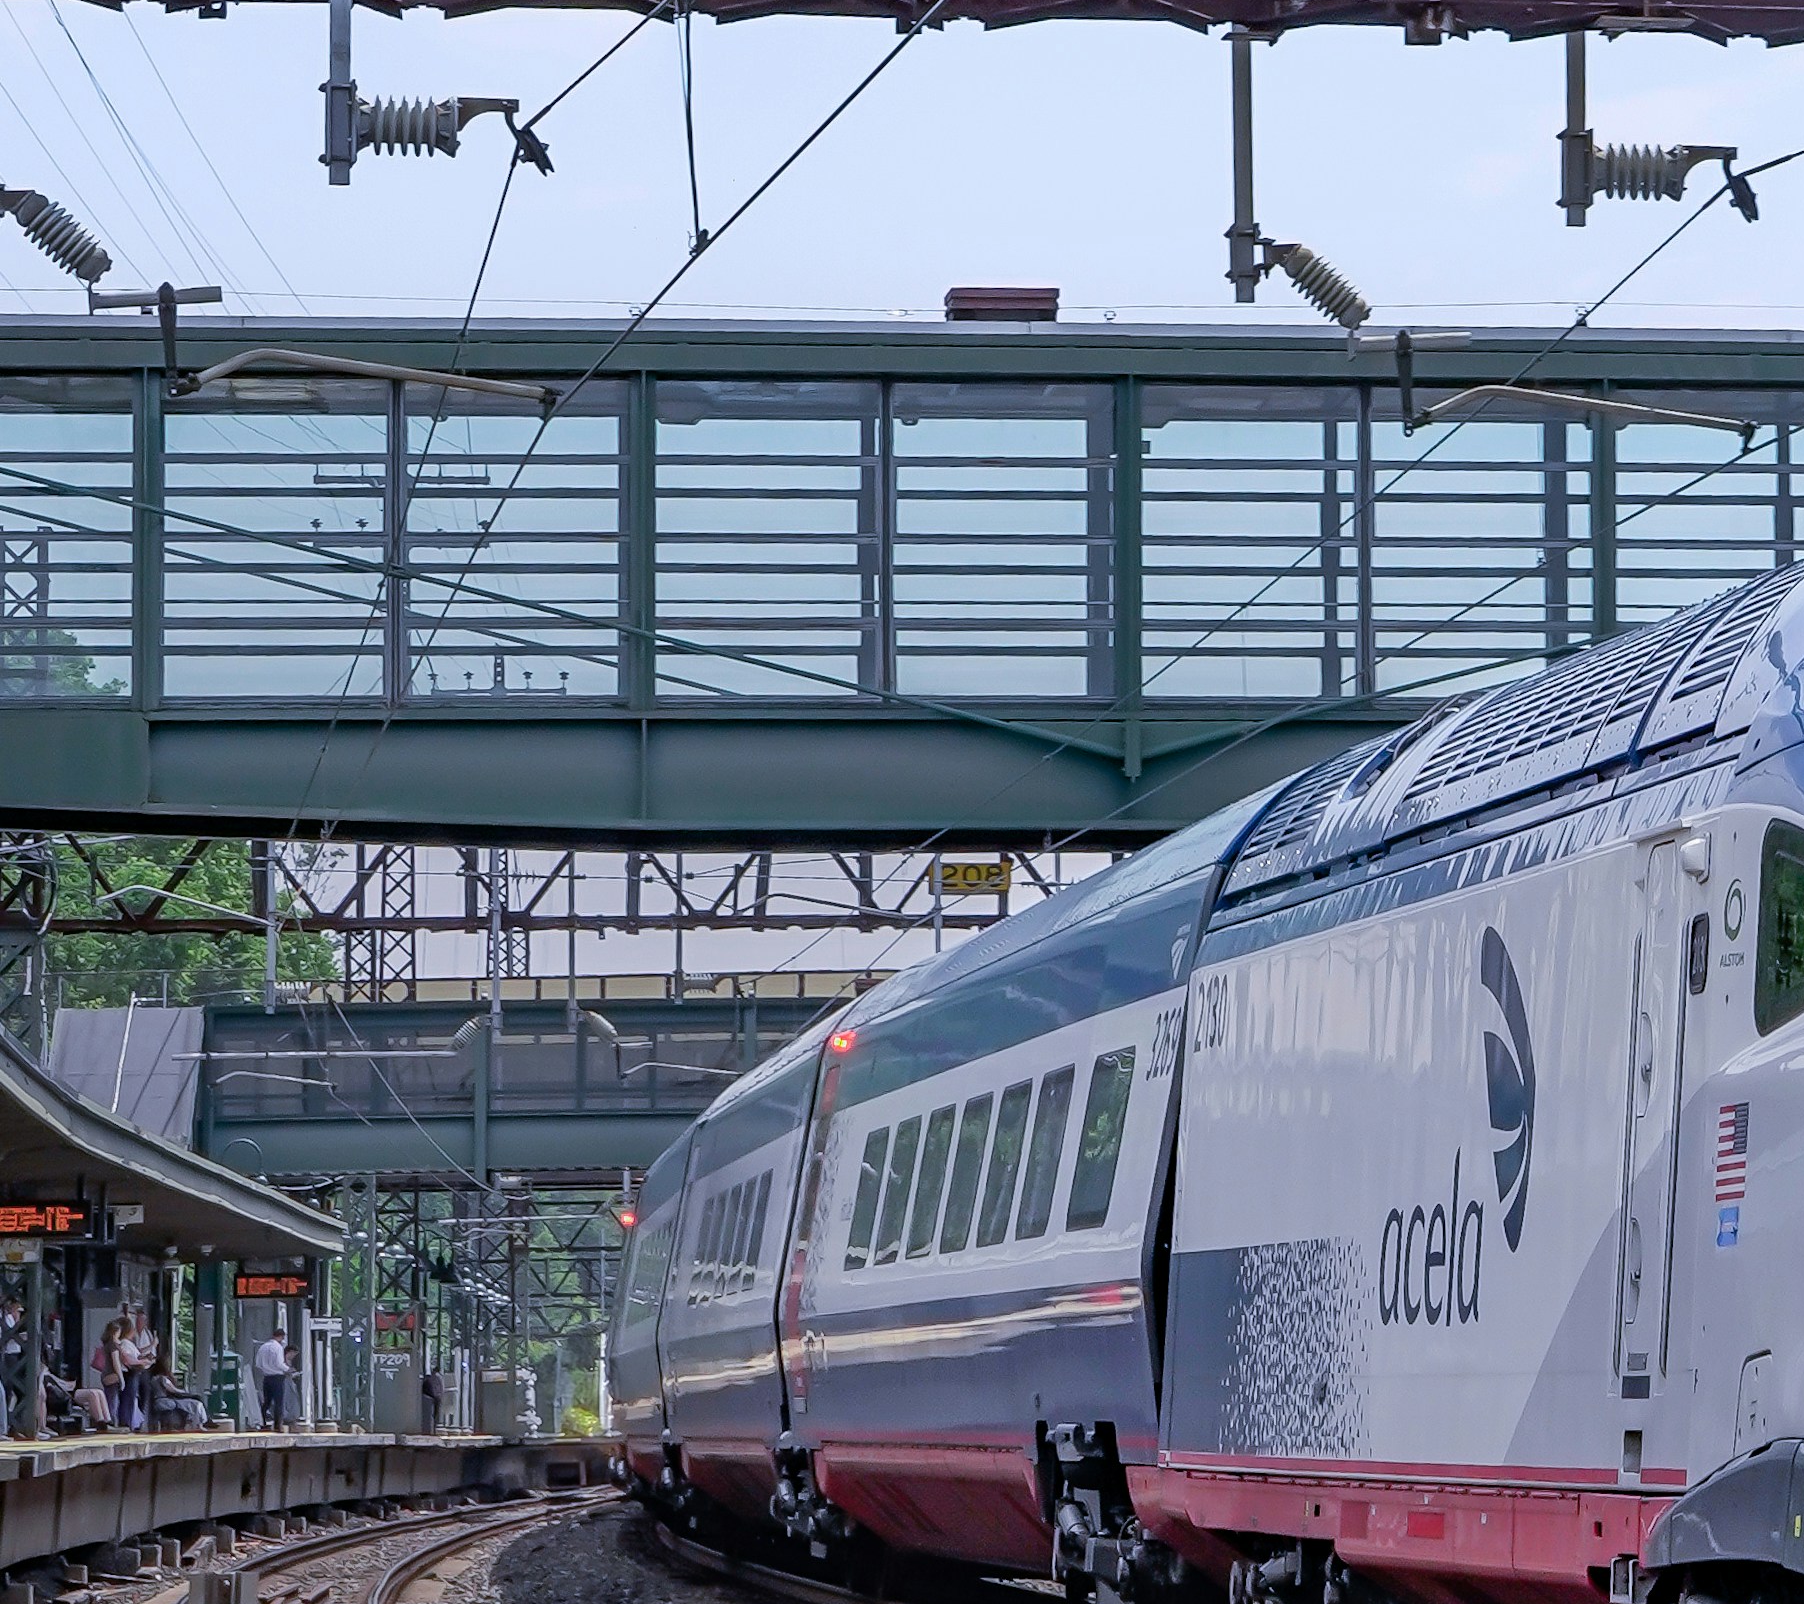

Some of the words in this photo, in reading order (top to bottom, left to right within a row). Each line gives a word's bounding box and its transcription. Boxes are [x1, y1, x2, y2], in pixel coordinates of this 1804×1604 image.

[942, 865, 1003, 888] 208
[1145, 1006, 1182, 1081] 3269
[1193, 974, 1228, 1053] 2130
[1379, 1145, 1484, 1327] acela
